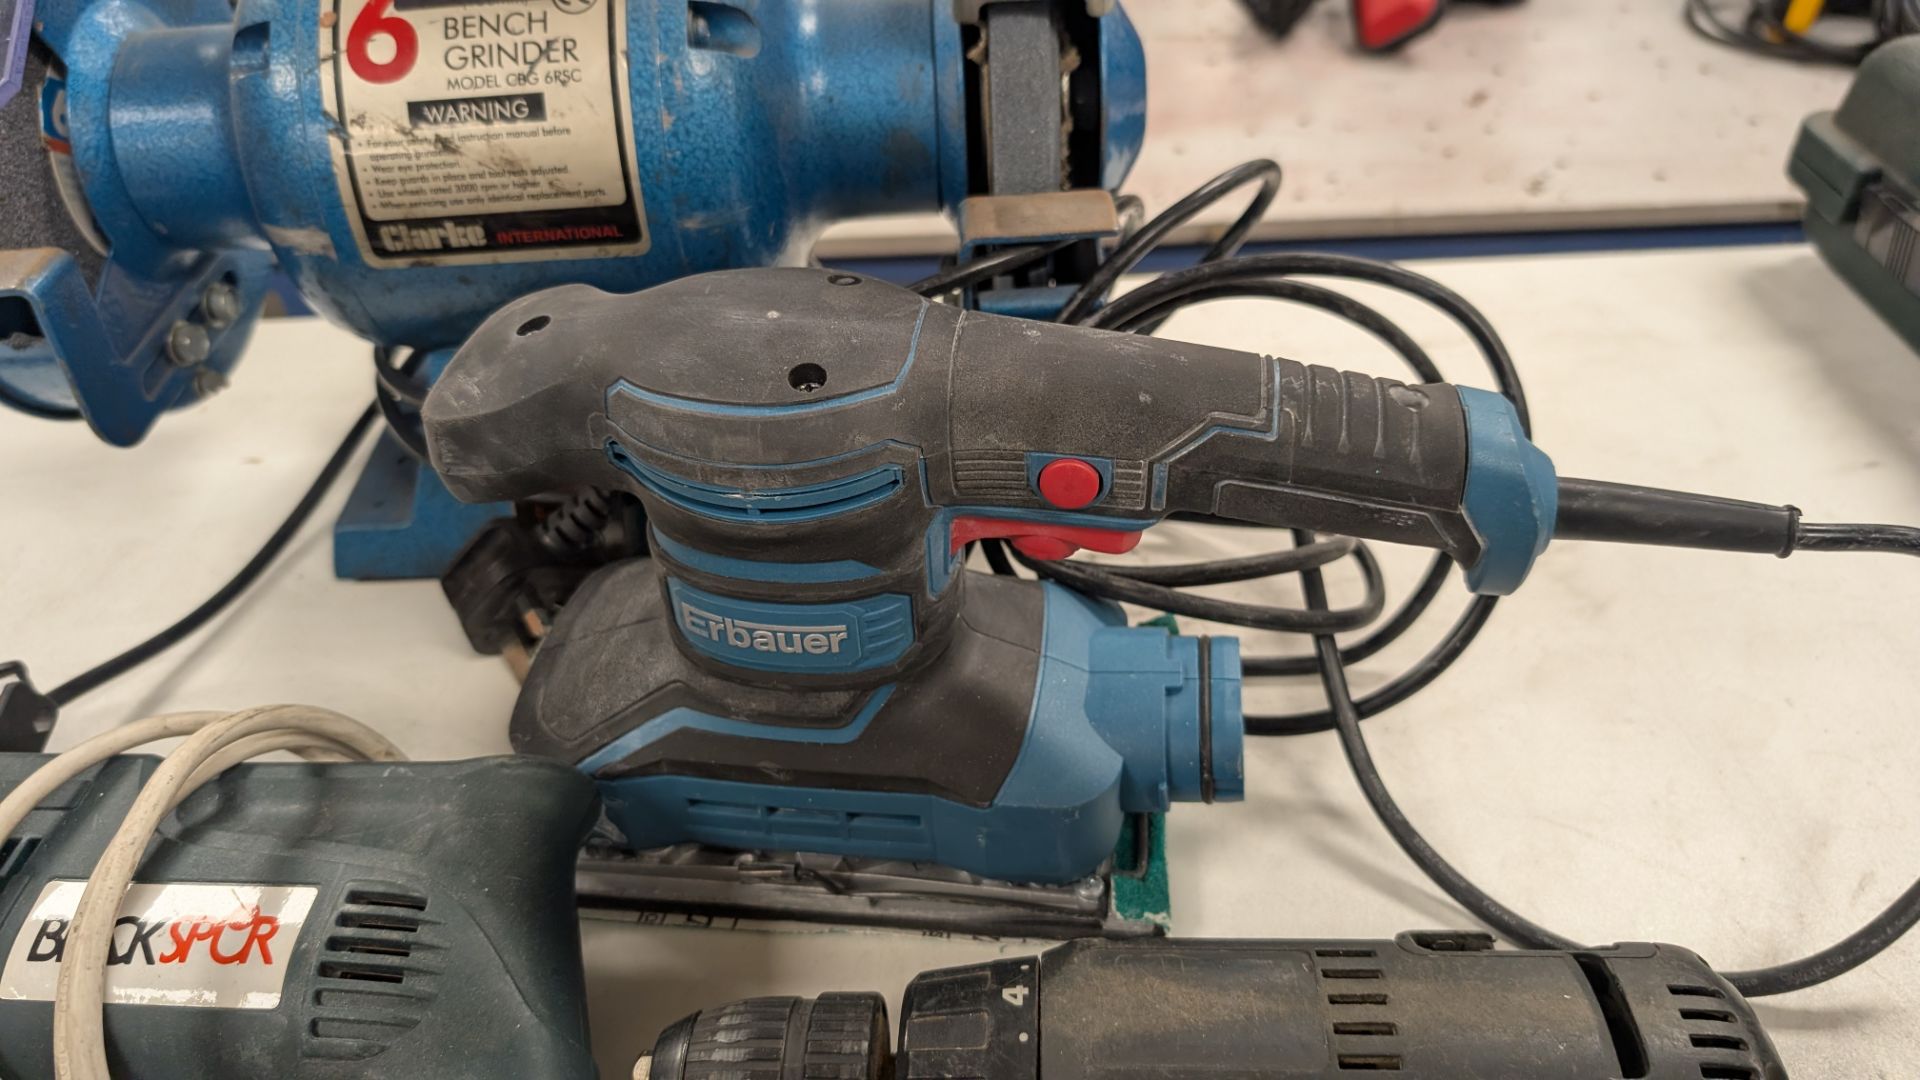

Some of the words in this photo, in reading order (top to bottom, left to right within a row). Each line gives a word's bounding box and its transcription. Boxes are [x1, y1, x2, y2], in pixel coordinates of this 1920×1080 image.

[444, 10, 548, 40] BENCH
[347, 0, 419, 84] 6
[444, 37, 579, 70] GRINDER
[446, 75, 501, 91] MODEL
[505, 71, 539, 87] CBG
[544, 69, 582, 86] 6RSC
[423, 98, 529, 123] WARNING
[506, 128, 540, 138] manual
[542, 126, 571, 137] before
[469, 170, 486, 179] and
[379, 221, 487, 251] Clarke
[497, 226, 623, 245] INTERNATIONAL
[681, 602, 847, 654] Erbauer
[27, 906, 280, 965] BLCKSPUR
[1002, 984, 1029, 1007] 4
